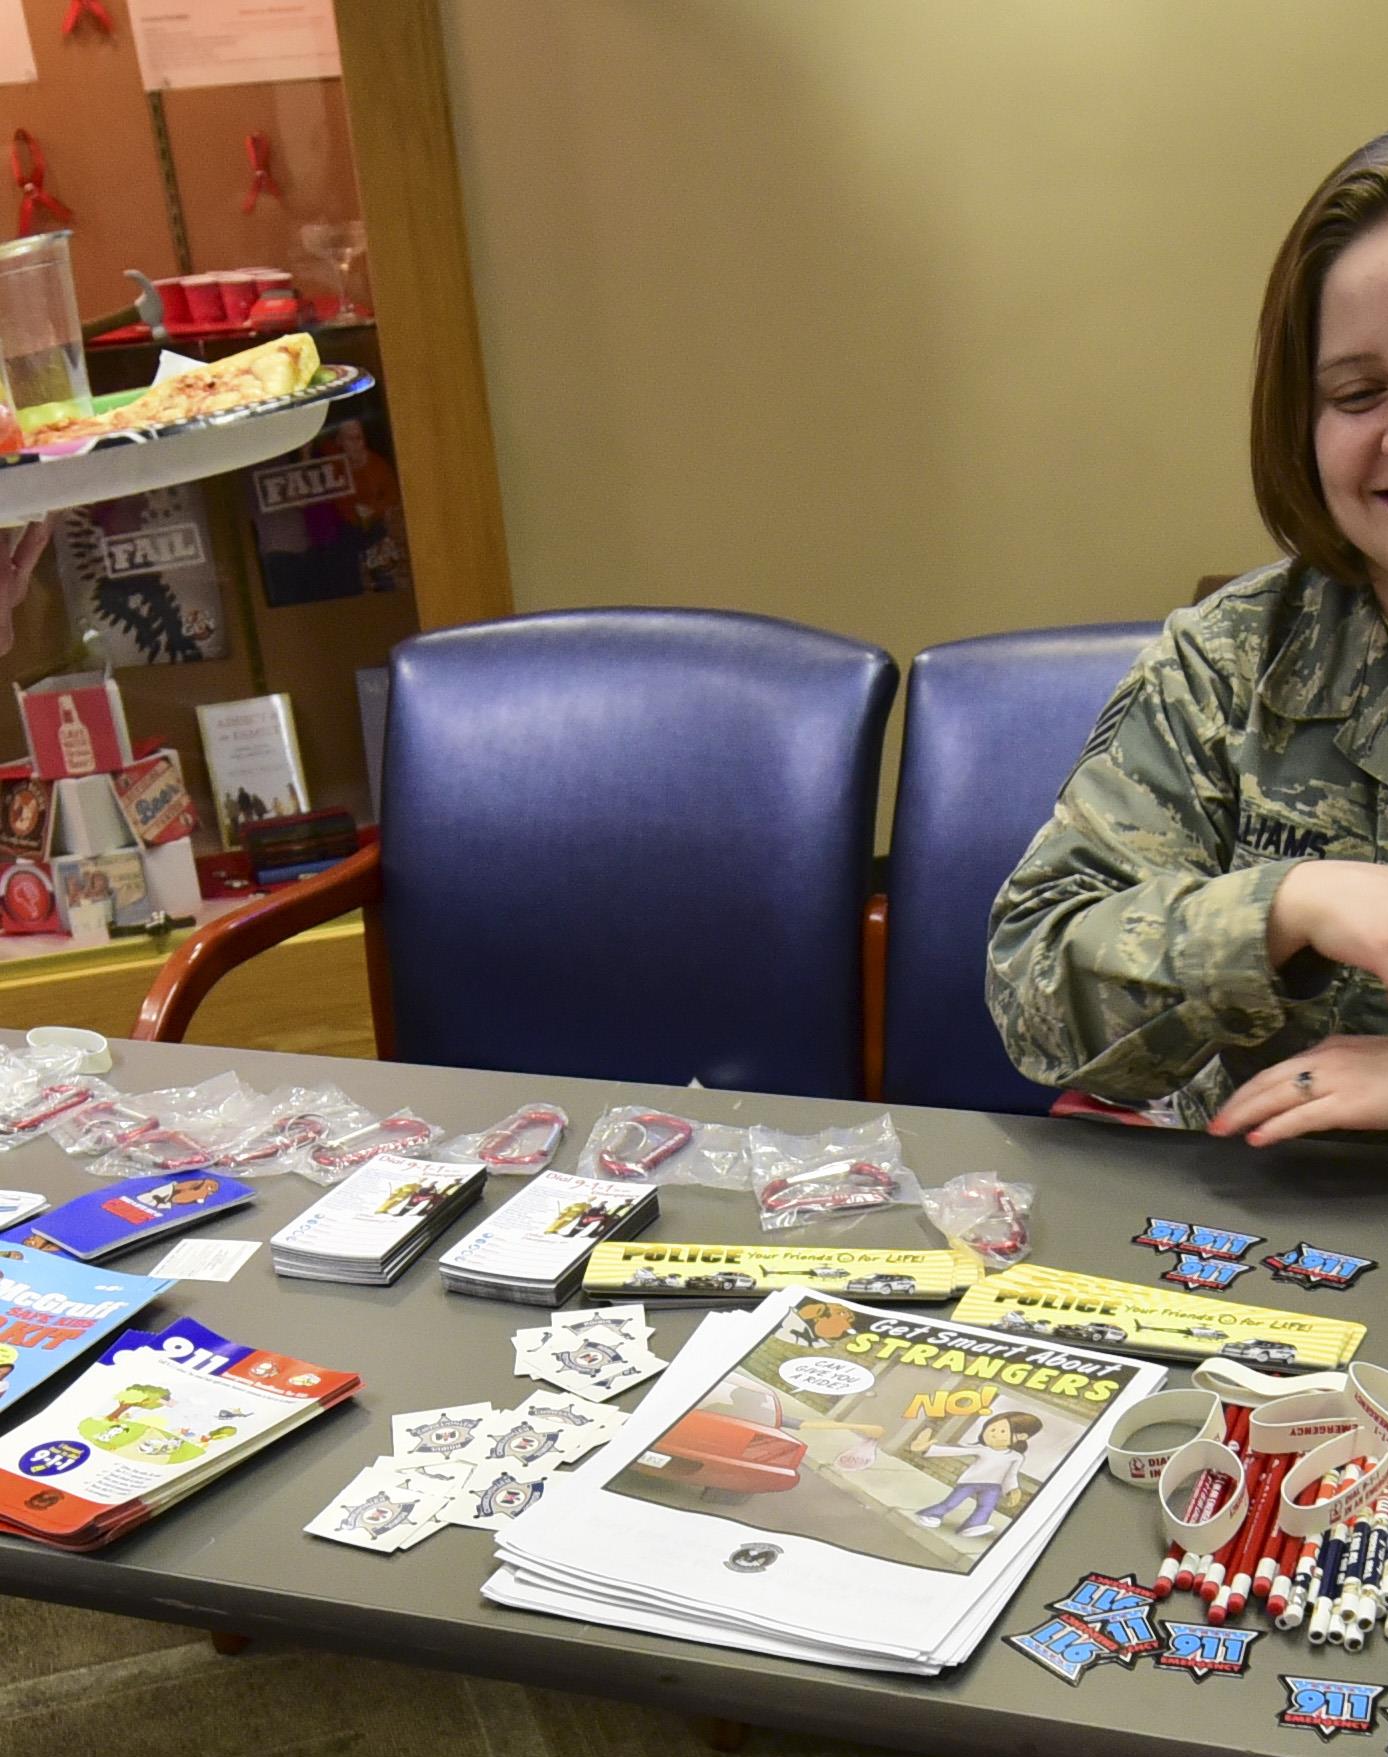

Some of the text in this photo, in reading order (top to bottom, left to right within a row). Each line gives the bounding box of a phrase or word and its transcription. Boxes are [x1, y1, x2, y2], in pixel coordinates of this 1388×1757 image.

[264, 467, 346, 503] FAIL
[108, 532, 195, 571] FAIL
[1240, 813, 1330, 860] LIAMS
[545, 1171, 615, 1193] Dial 9-1-1
[622, 1247, 744, 1264] POLICE
[747, 1252, 778, 1262] Your
[783, 1252, 833, 1262] Friends
[1190, 1232, 1248, 1255] 911
[1176, 1261, 1237, 1283] 911
[1299, 1254, 1358, 1279] 911
[0, 1279, 130, 1319] McGruff
[993, 1288, 1118, 1316] POLICE
[1125, 1304, 1156, 1315] Your
[1161, 1308, 1214, 1322] Friends
[162, 1336, 230, 1376] 911
[869, 1316, 1124, 1378] Get Smart About
[795, 1365, 861, 1384] GIVE YOU
[815, 1360, 847, 1372] CAN
[845, 1332, 1121, 1403] STRANGERS
[803, 1376, 851, 1391] RIDE?
[902, 1385, 1000, 1420] NO!
[1030, 1621, 1101, 1663] 911
[1170, 1628, 1245, 1664] 911
[1161, 1655, 1242, 1673] EMERGENCY
[1294, 1683, 1370, 1720] 911
[1284, 1713, 1371, 1731] EMERGENCY
